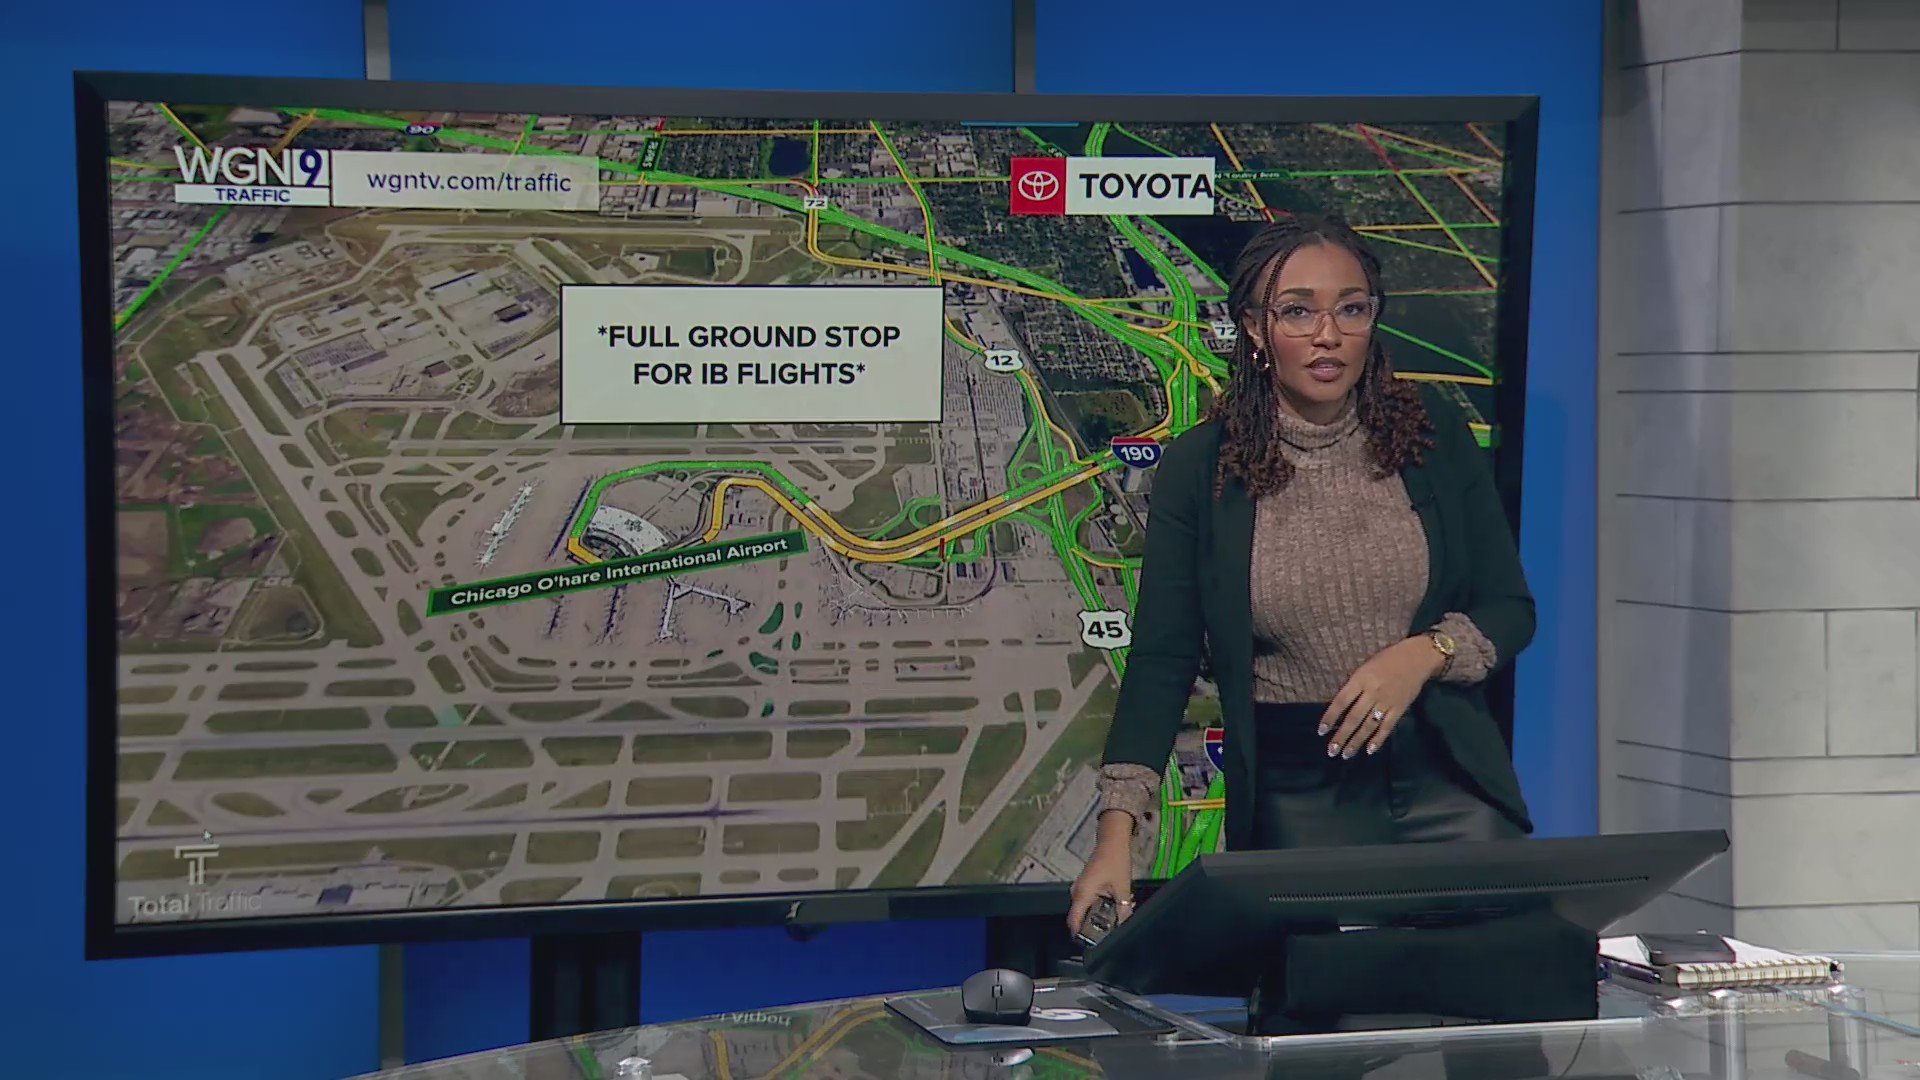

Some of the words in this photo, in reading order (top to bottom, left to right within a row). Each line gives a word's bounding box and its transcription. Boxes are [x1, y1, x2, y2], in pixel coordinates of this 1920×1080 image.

[367, 172, 572, 194] wgntv.com/traffic
[1079, 173, 1214, 199] TOYOTA
[214, 187, 291, 203] TRAFFIC
[806, 198, 826, 208] 72
[688, 325, 817, 348] GROUND
[824, 325, 901, 348] STOP
[1218, 326, 1237, 338] 72
[990, 354, 1014, 367] 12
[633, 362, 692, 385] FOR
[701, 362, 729, 385] IB
[1120, 446, 1155, 461] 190
[451, 584, 532, 605] Chicago
[537, 571, 601, 592] O'hare
[606, 549, 722, 580] International
[726, 538, 789, 560] Airport
[1087, 620, 1124, 640] 45
[128, 894, 190, 915] Total
[195, 889, 262, 913] Traffic
